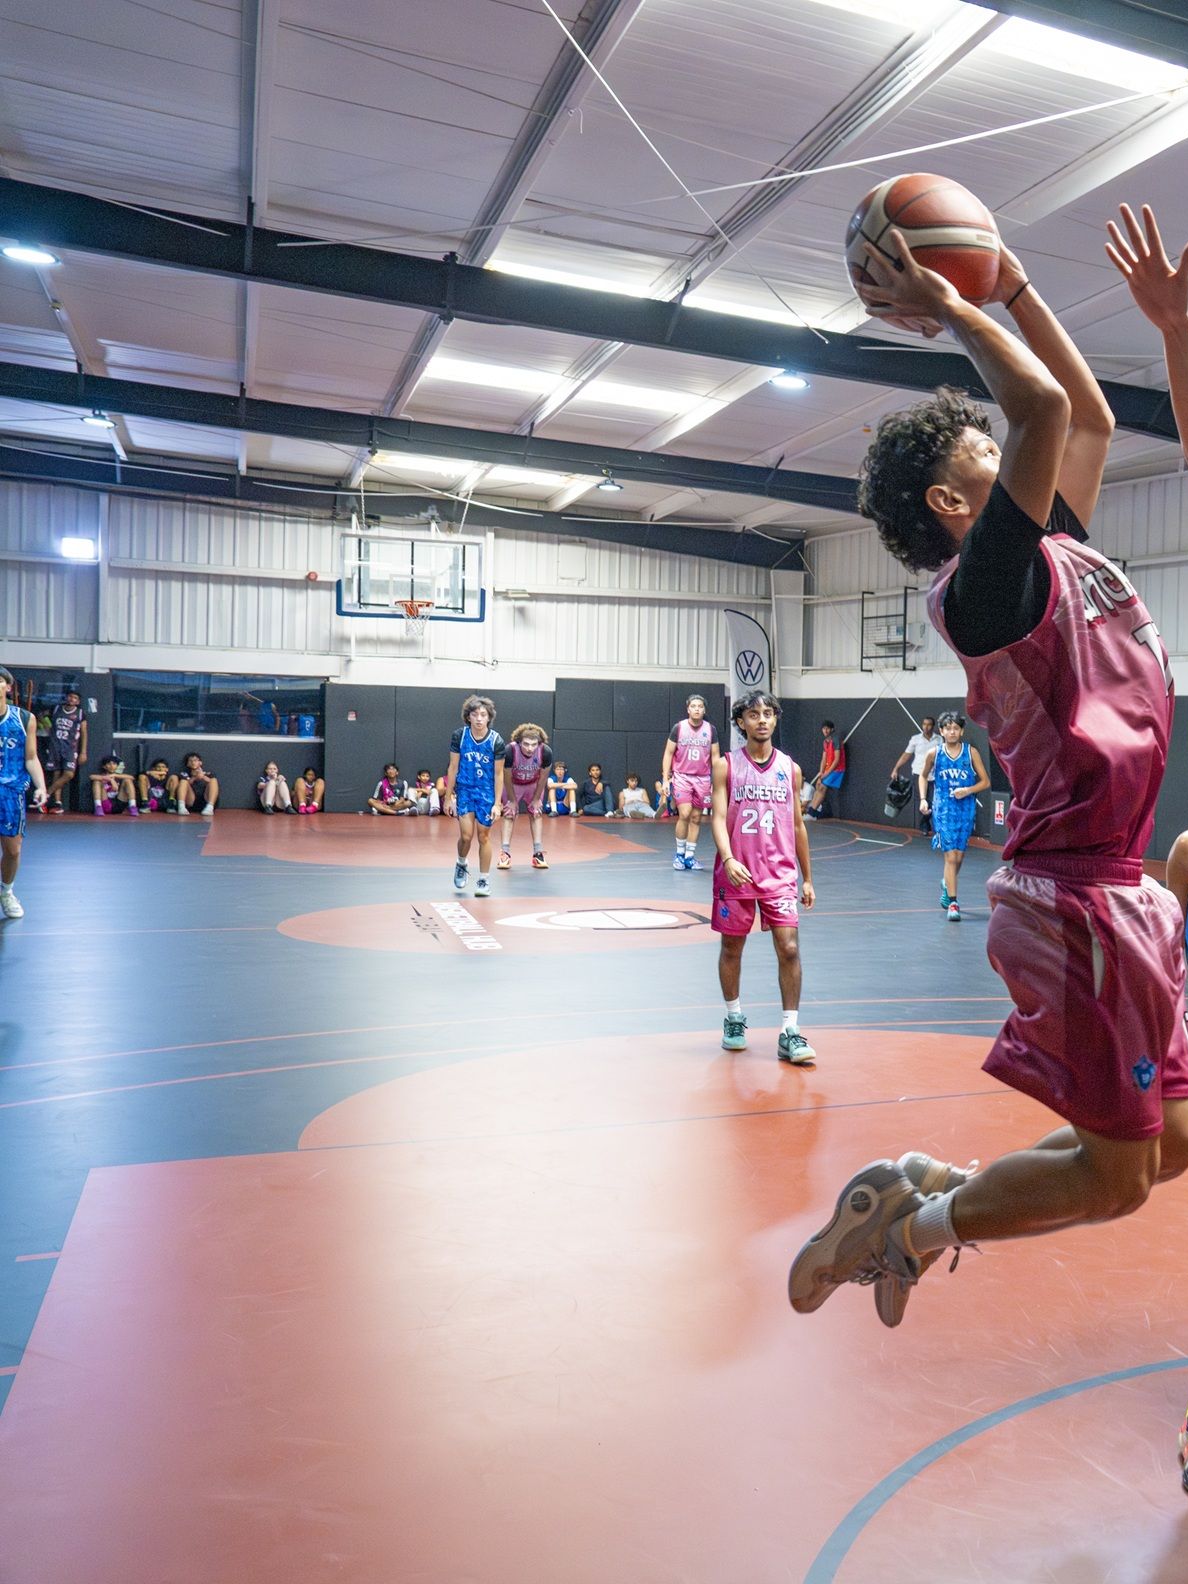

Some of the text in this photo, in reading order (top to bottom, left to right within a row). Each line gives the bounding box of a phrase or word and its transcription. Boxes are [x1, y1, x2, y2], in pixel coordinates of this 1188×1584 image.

[687, 748, 701, 761] 19
[939, 768, 968, 780] TWS
[741, 809, 775, 835] 24
